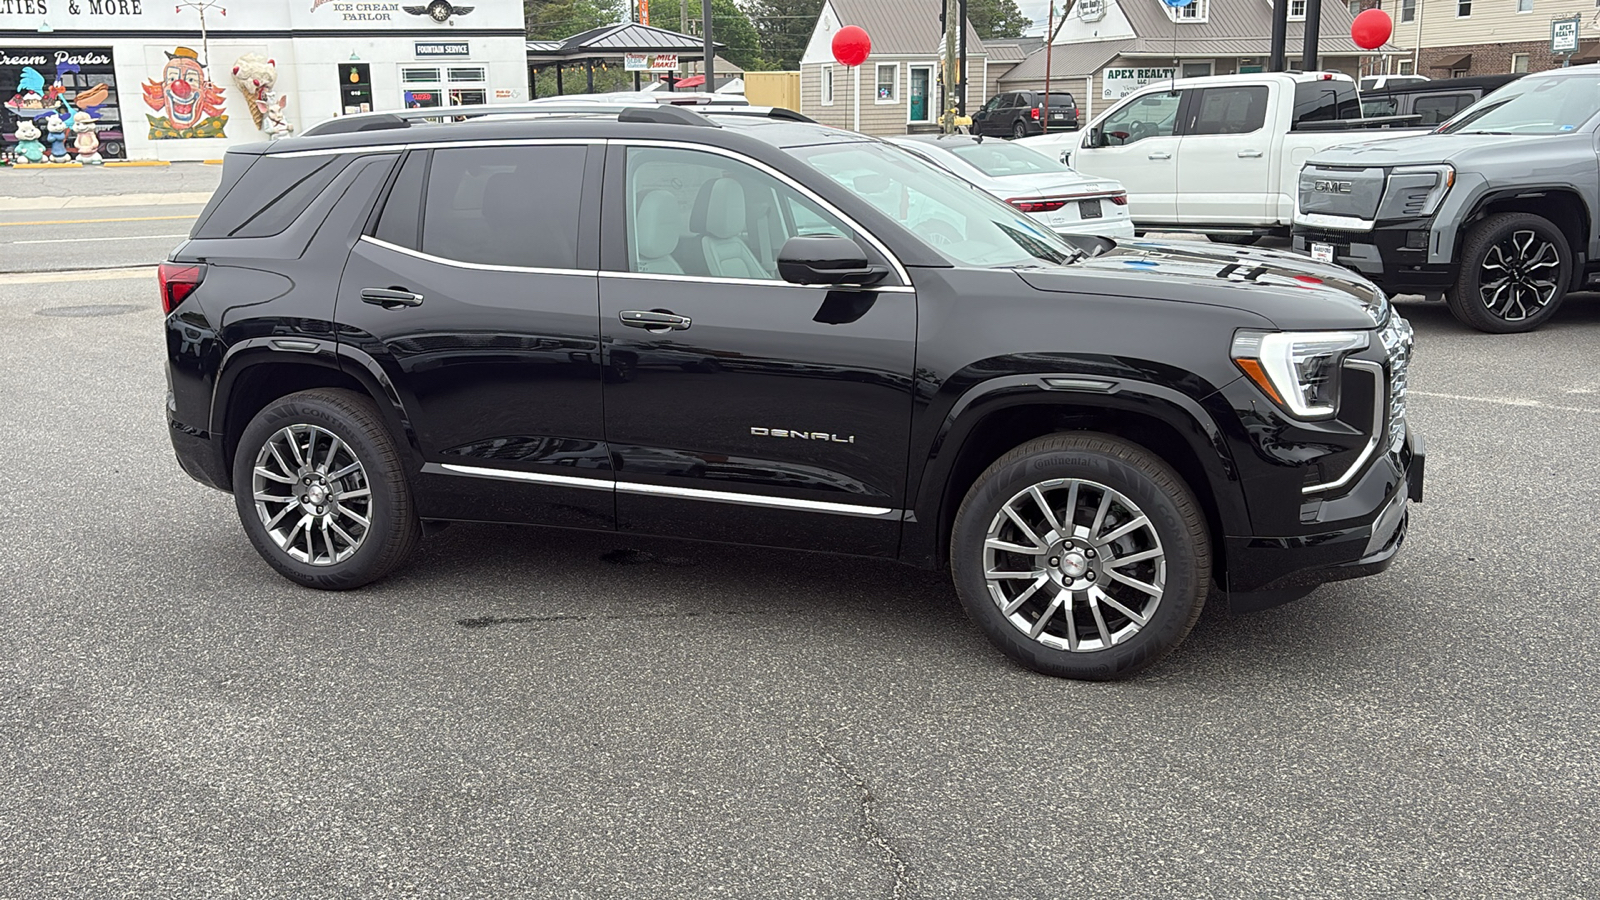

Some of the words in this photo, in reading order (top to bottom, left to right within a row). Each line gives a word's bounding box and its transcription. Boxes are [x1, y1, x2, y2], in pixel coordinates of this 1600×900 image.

[69, 1, 81, 15] &
[89, 0, 142, 15] MORE
[334, 3, 355, 11] ICE
[356, 3, 399, 11] CREAM
[343, 13, 391, 21] PARLOR
[417, 45, 445, 54] FOUNTAIN
[445, 45, 468, 53] SERVICE
[54, 51, 110, 65] Parlor
[1107, 69, 1135, 79] APEX
[1137, 69, 1176, 79] REALTY
[1314, 180, 1352, 194] GMC
[750, 427, 854, 444] DENALI
[1034, 456, 1091, 469] Continental
